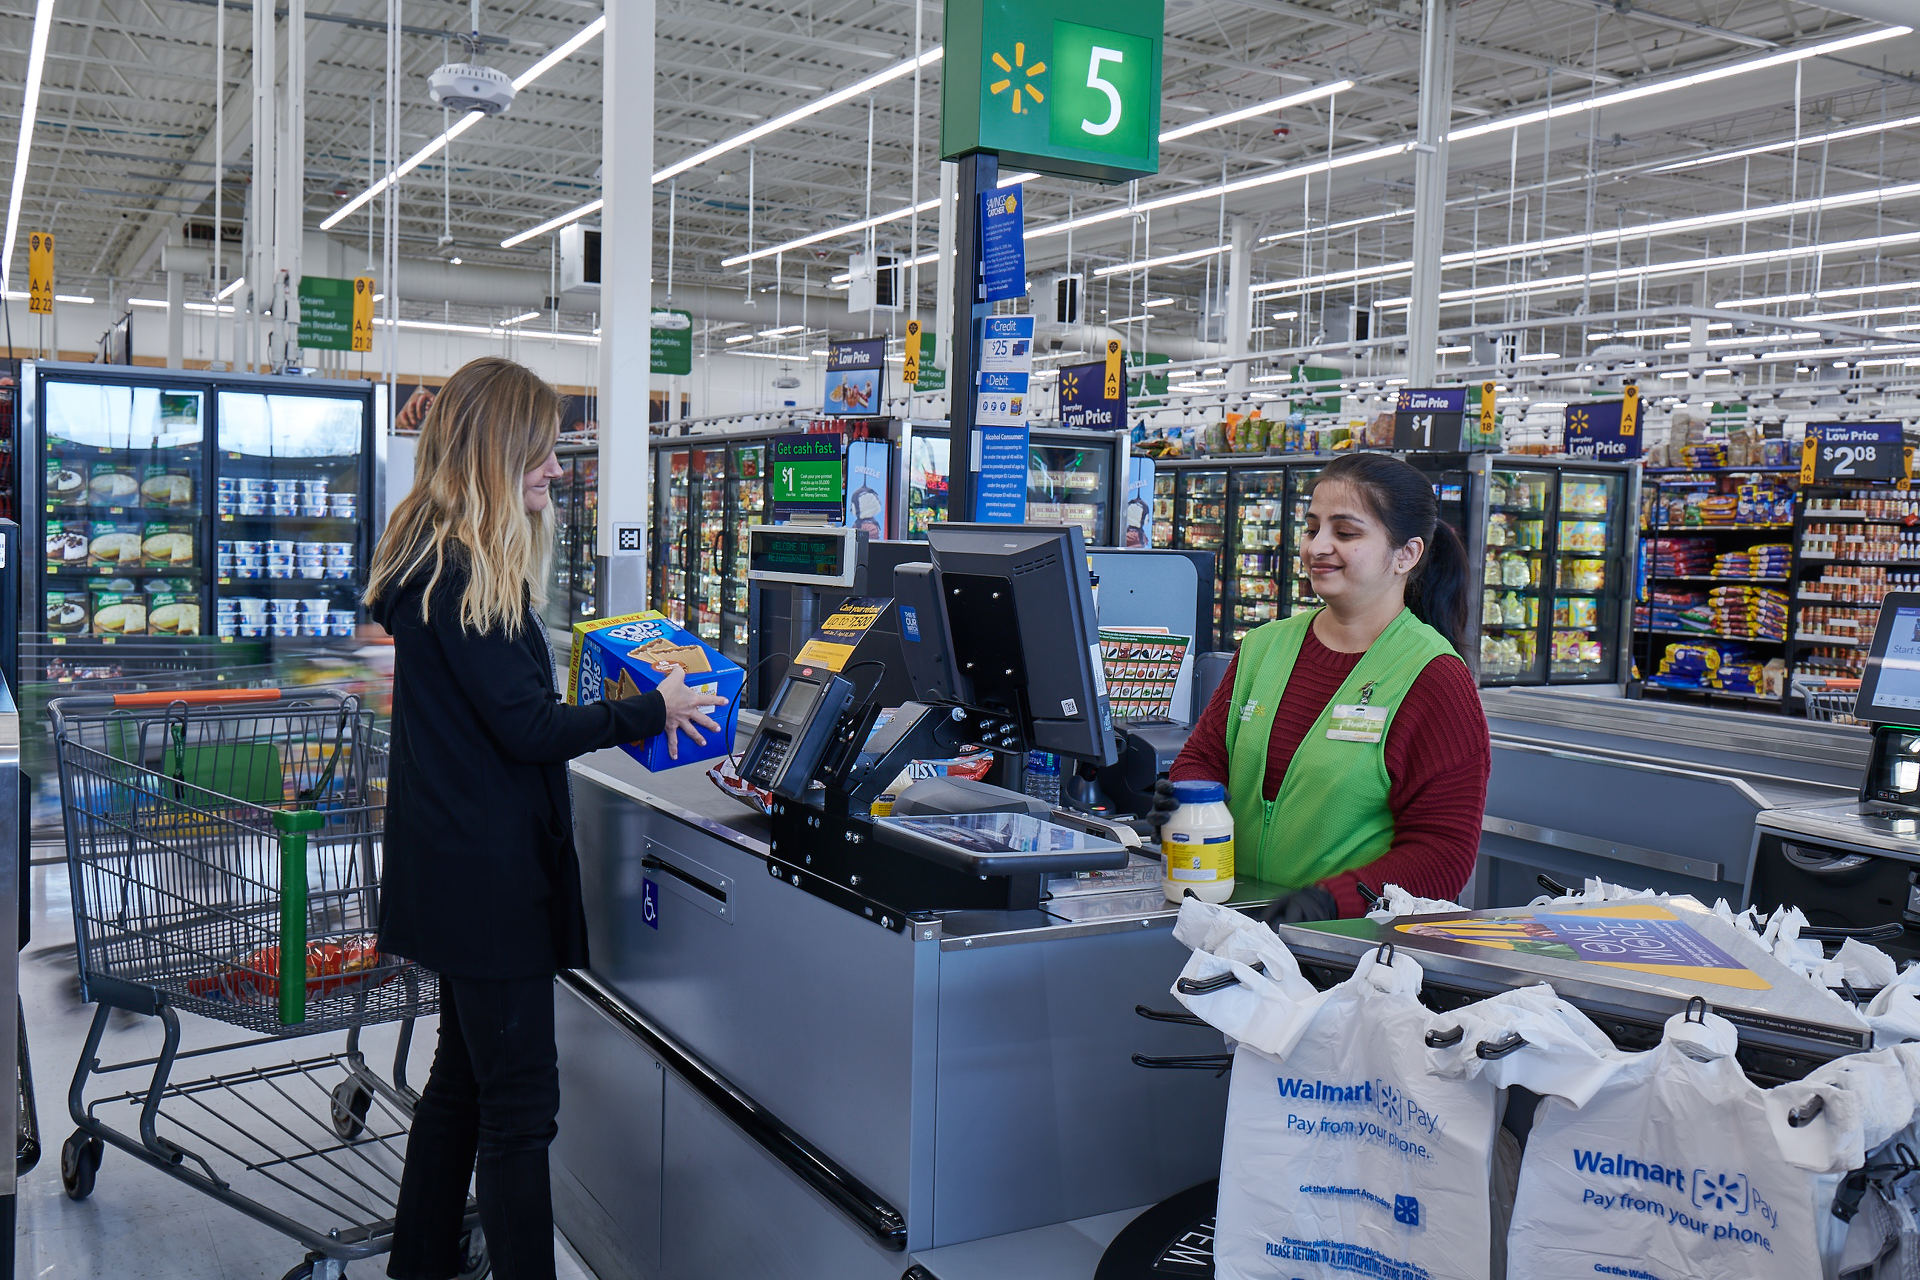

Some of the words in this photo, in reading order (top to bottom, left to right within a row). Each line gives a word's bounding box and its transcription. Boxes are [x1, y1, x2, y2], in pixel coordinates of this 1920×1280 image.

[1081, 46, 1123, 135] 5
[31, 278, 39, 292] A
[44, 280, 51, 293] A
[30, 297, 40, 310] 22
[43, 298, 52, 312] 22
[312, 309, 336, 319] Bread
[312, 321, 348, 331] Breakfast
[355, 319, 362, 331] A
[994, 320, 1017, 332] Credit
[312, 333, 333, 342] Pizza
[354, 337, 362, 348] 21
[992, 340, 1008, 356] $25
[839, 352, 853, 364] Low
[854, 350, 870, 364] Price
[906, 356, 915, 367] A
[903, 370, 916, 381] 20
[989, 374, 1009, 386] Debit
[1108, 372, 1116, 383] A
[917, 380, 928, 388] Dog
[1107, 386, 1117, 396] 19
[1062, 403, 1083, 413] Everyday
[1411, 398, 1428, 408] Low
[1428, 397, 1449, 408] Price
[1062, 412, 1084, 426] Low
[1085, 408, 1112, 425] Price
[1483, 410, 1492, 419] A
[1624, 413, 1633, 422] A
[1412, 414, 1433, 447] $1
[1482, 422, 1492, 432] 18
[1623, 425, 1632, 433] 17
[985, 433, 1001, 441] Alcohol
[1826, 431, 1849, 441] Low
[1851, 430, 1879, 441] Price
[777, 442, 791, 455] Get
[793, 441, 813, 455] cash
[815, 441, 836, 454] fast.
[1569, 443, 1594, 456] Low
[1596, 440, 1627, 454] Price
[1804, 463, 1812, 472] A
[1803, 474, 1812, 482] 16
[840, 603, 853, 612] Cash
[850, 605, 865, 613] your
[864, 604, 883, 613] refund
[600, 618, 620, 626] VALUE
[622, 614, 640, 623] PACK
[827, 617, 839, 628] up
[839, 617, 849, 626] to
[1893, 645, 1914, 655] Start
[1560, 923, 1627, 954] ONE
[1599, 921, 1686, 962] MORE
[1277, 1077, 1373, 1102] Walmart
[1407, 1100, 1439, 1134] Pay
[1287, 1114, 1315, 1135] Pay
[1320, 1117, 1354, 1133] from
[1359, 1121, 1388, 1140] your
[1389, 1132, 1431, 1159] phone.
[1573, 1149, 1685, 1193] Walmart
[1752, 1187, 1779, 1229] Pay
[1299, 1185, 1312, 1193] Get
[1313, 1185, 1327, 1193] the
[1327, 1186, 1361, 1196] Walmart
[1361, 1189, 1375, 1200] App
[1375, 1194, 1392, 1210] today.
[1583, 1188, 1615, 1210] Pay
[1620, 1193, 1664, 1216] from
[1669, 1207, 1708, 1234] your
[1714, 1222, 1774, 1254] phone.
[1282, 1236, 1302, 1245] Please
[1266, 1242, 1291, 1259] PLEASE
[1292, 1246, 1321, 1263] RETURN
[1321, 1249, 1330, 1262] TO
[1331, 1250, 1336, 1264] A
[1337, 1251, 1382, 1275] PARTICIPATING
[1382, 1263, 1400, 1280] STORE
[1594, 1263, 1611, 1274] Get
[1612, 1266, 1628, 1276] the
